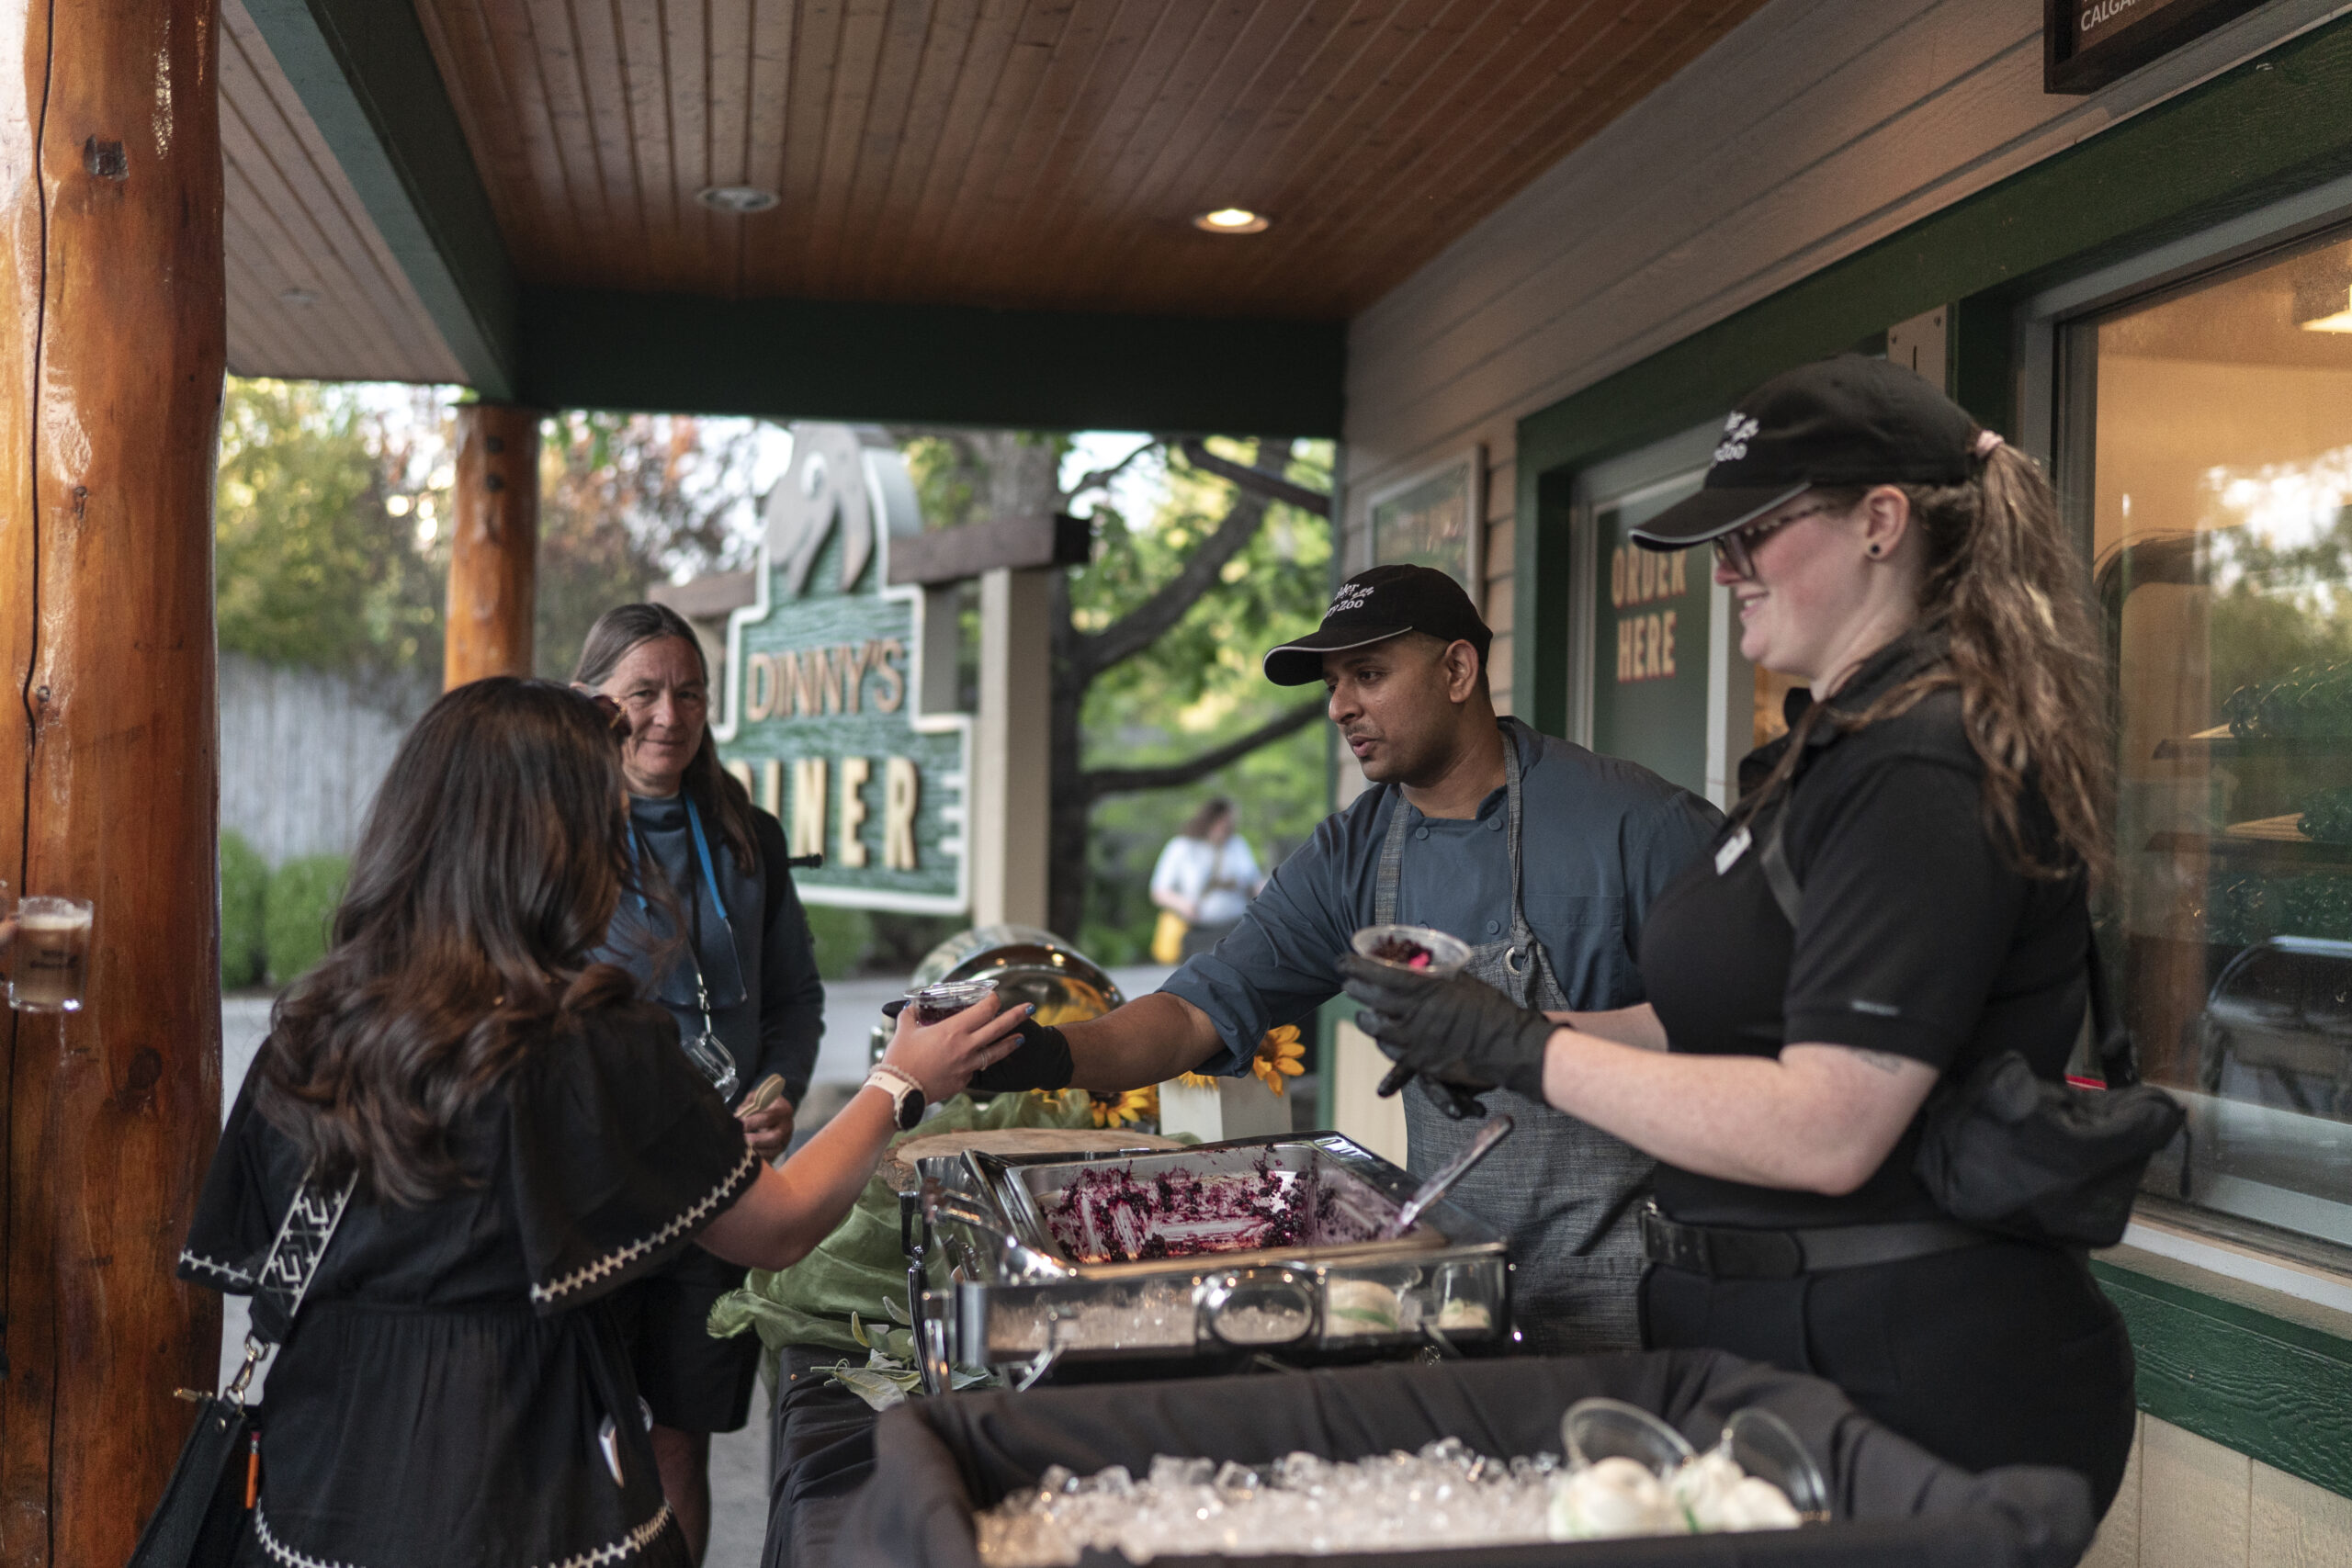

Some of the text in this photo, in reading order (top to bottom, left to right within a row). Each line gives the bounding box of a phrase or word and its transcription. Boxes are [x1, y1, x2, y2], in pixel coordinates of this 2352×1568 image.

[2081, 0, 2137, 31] CALGA
[1611, 544, 1687, 609] ORDER
[746, 637, 904, 721] DINNY'S
[1618, 610, 1677, 682] HERE
